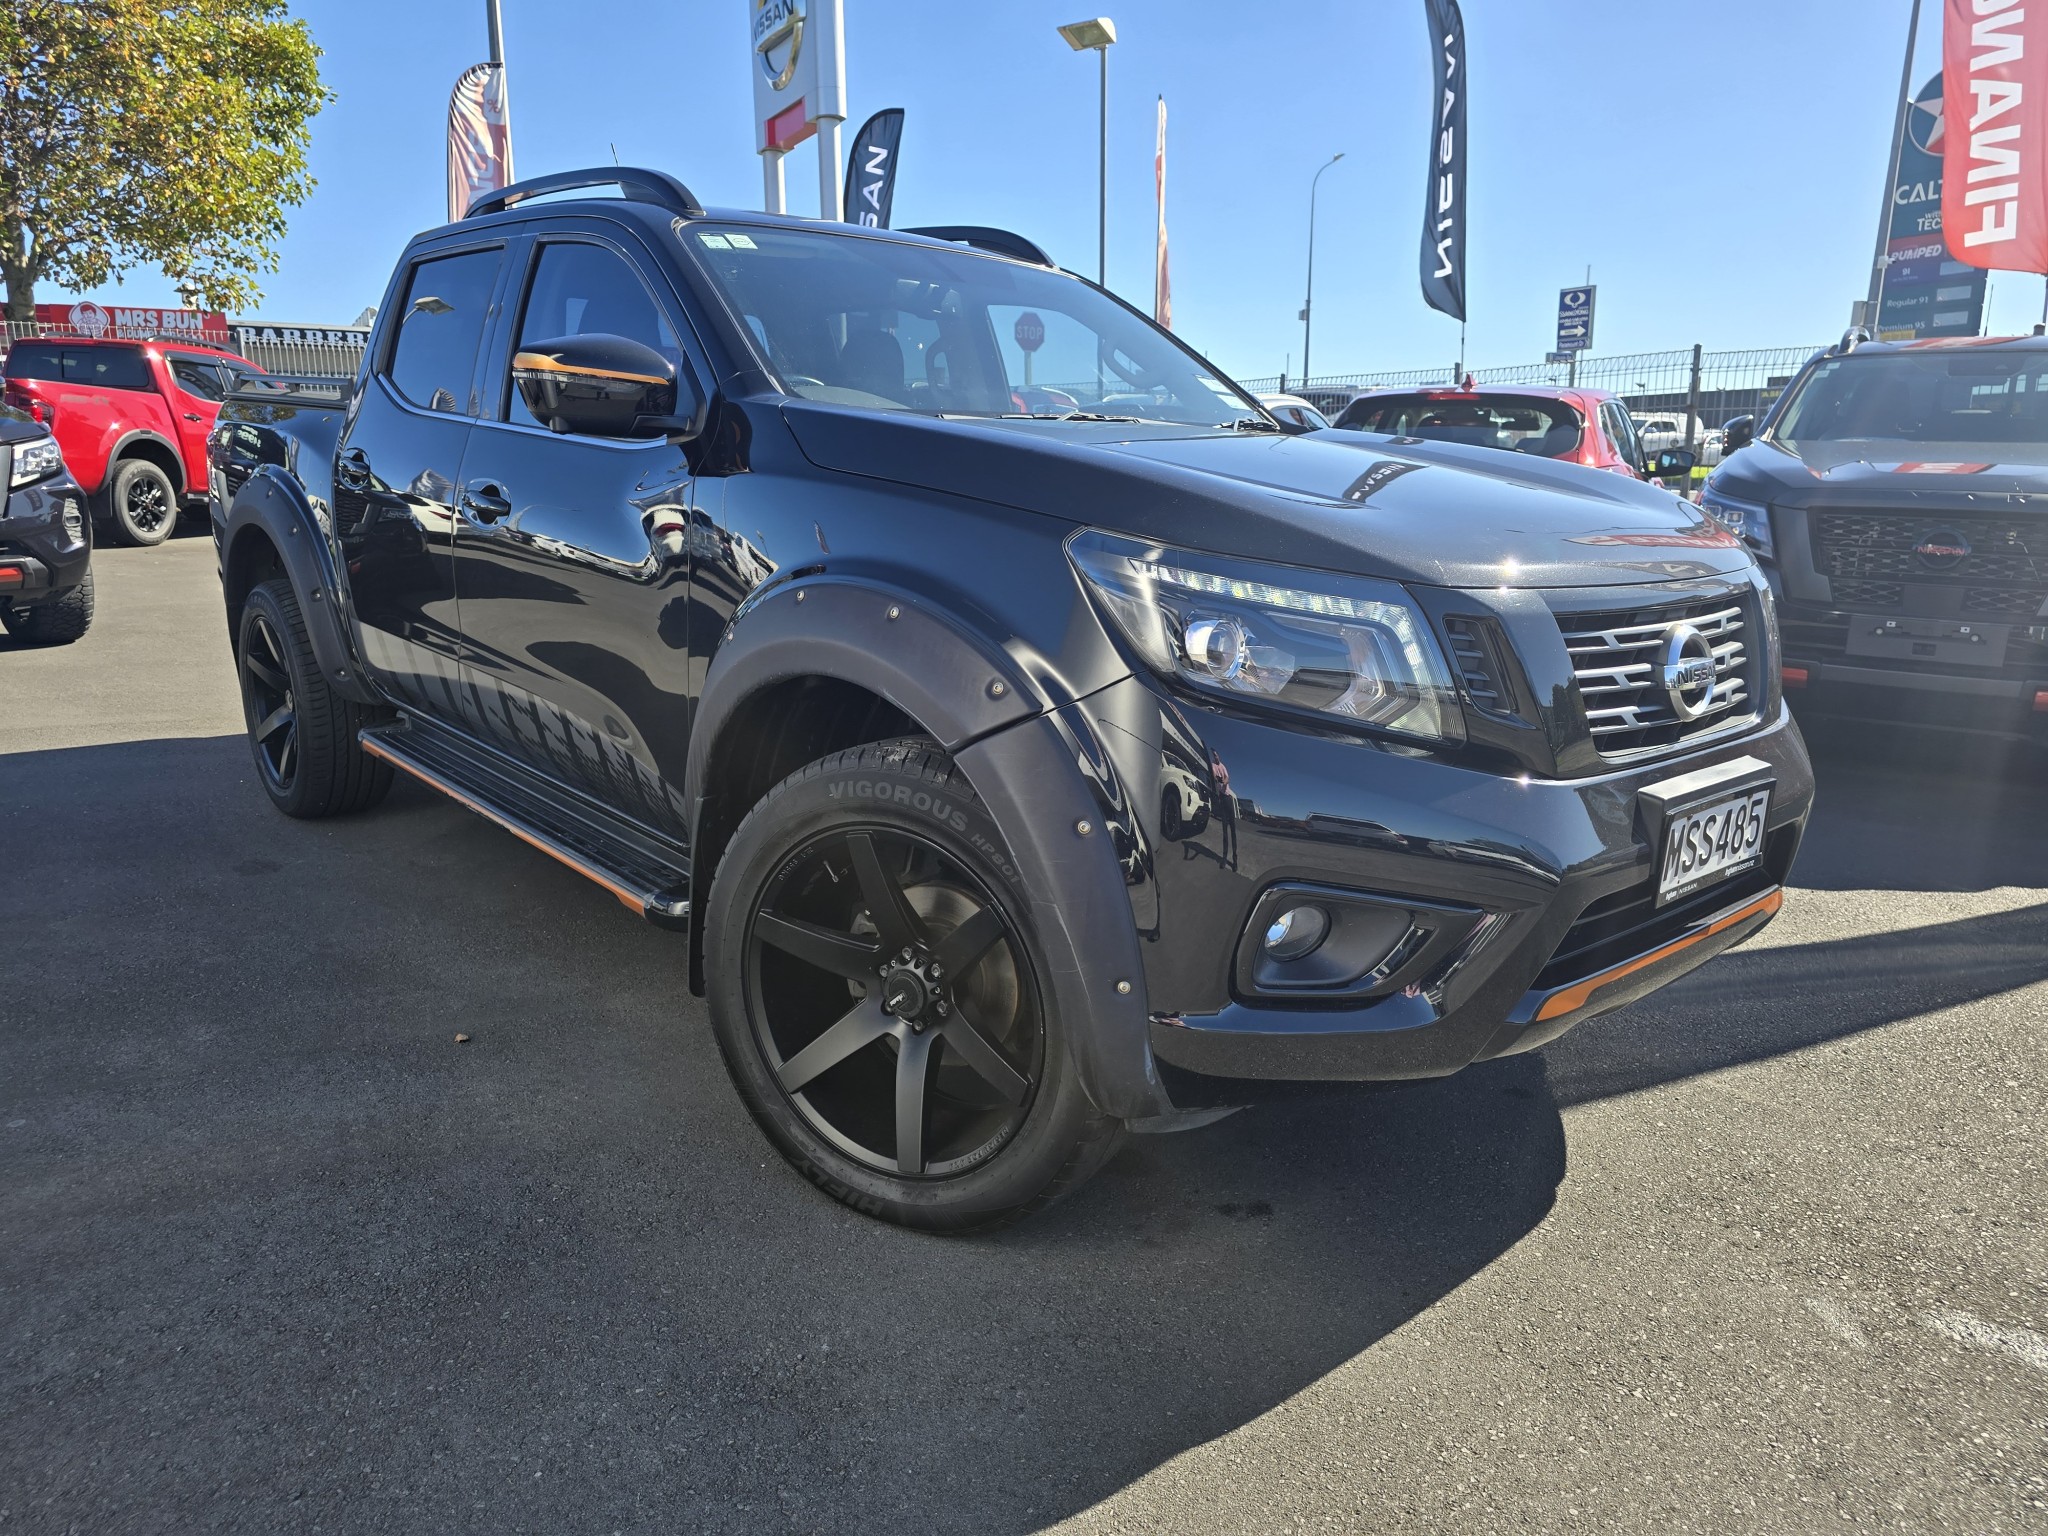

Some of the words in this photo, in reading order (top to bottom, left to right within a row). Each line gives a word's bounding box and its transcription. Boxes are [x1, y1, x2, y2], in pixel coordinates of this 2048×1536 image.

[1917, 218, 1943, 232] TEC
[1886, 297, 1917, 308] Regular
[1919, 296, 1929, 304] 91
[114, 309, 158, 328] MRS
[162, 311, 203, 329] BUN
[1915, 320, 1926, 329] 95
[238, 327, 370, 347] BARBER
[1016, 326, 1043, 340] STOP
[829, 780, 968, 831] VIGOROUS
[1663, 798, 1764, 882] MSS485
[970, 834, 1021, 883] HP801
[1679, 883, 1697, 895] NISSAN
